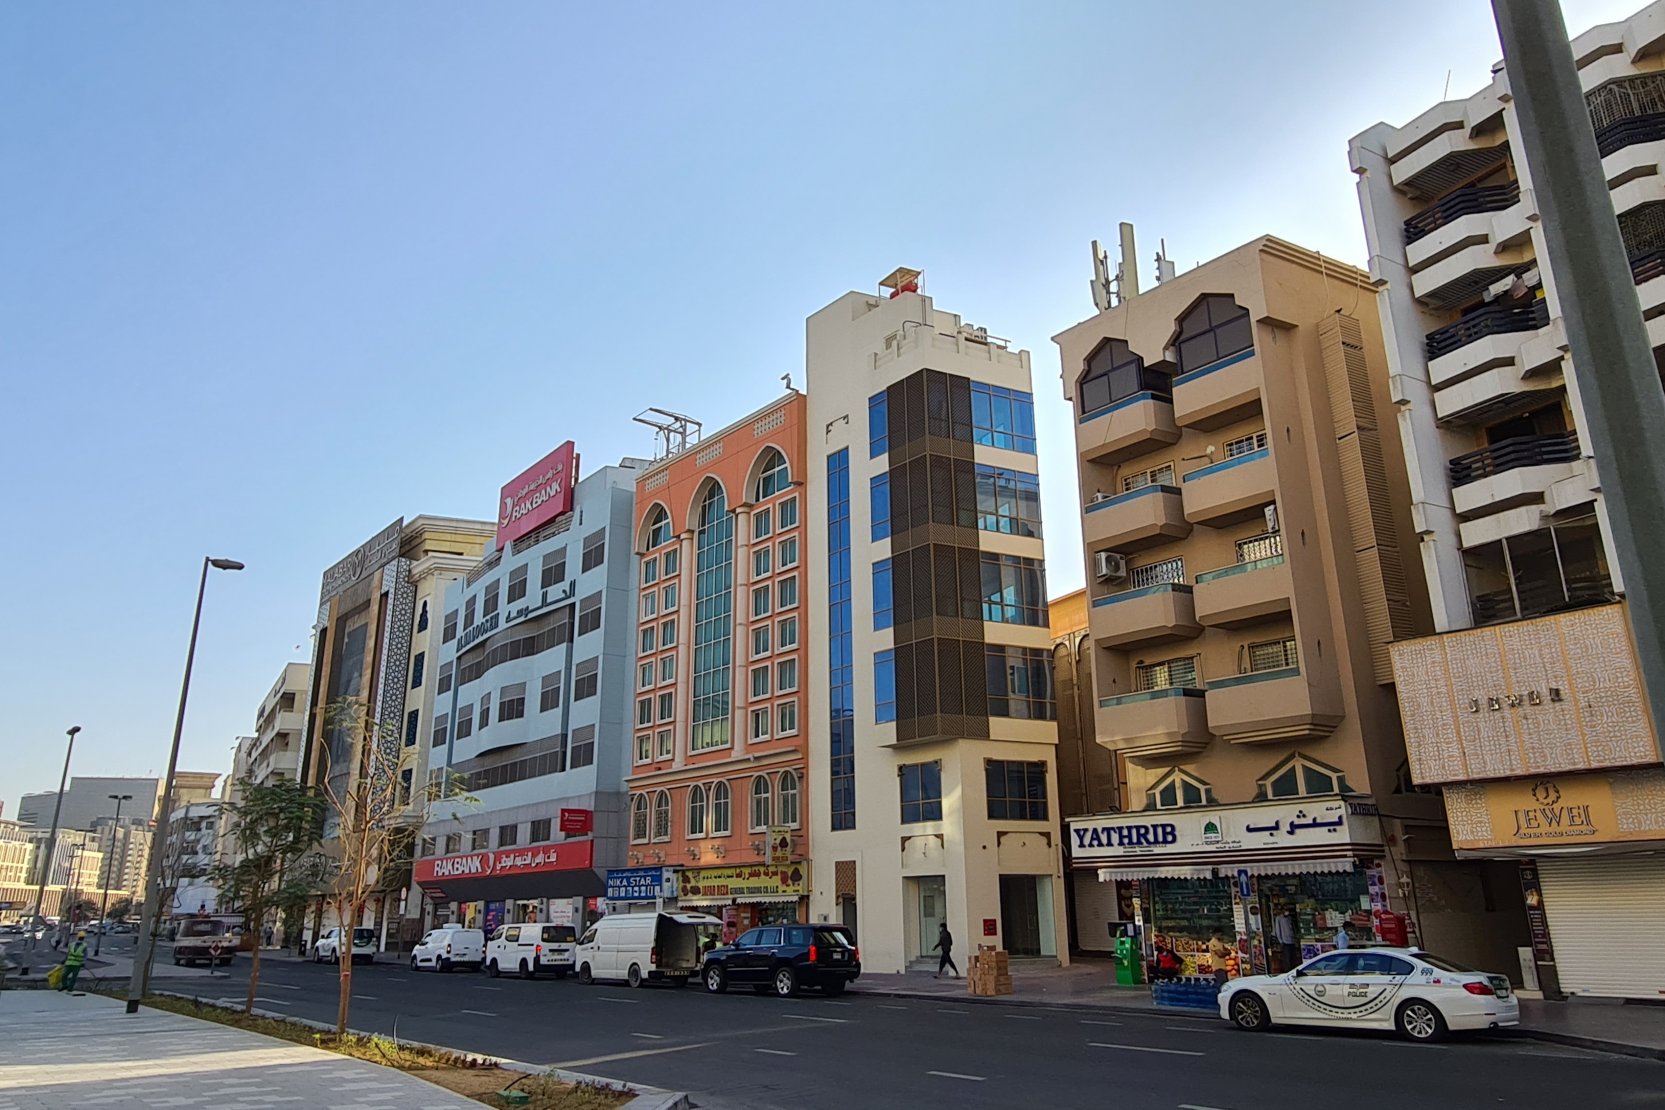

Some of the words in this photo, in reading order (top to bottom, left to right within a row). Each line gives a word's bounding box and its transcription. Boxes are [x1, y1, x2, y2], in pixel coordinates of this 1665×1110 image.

[511, 478, 561, 522] RAKBANK
[1512, 805, 1599, 837] JEWEL
[1073, 823, 1177, 848] YATHRIB
[433, 854, 483, 877] RAKBANK
[531, 850, 544, 867] رأس
[545, 849, 557, 866] بنك
[608, 877, 628, 887] NIKA
[630, 876, 652, 887] STAR
[1420, 966, 1433, 976] 999
[1347, 990, 1369, 998] POLICE
